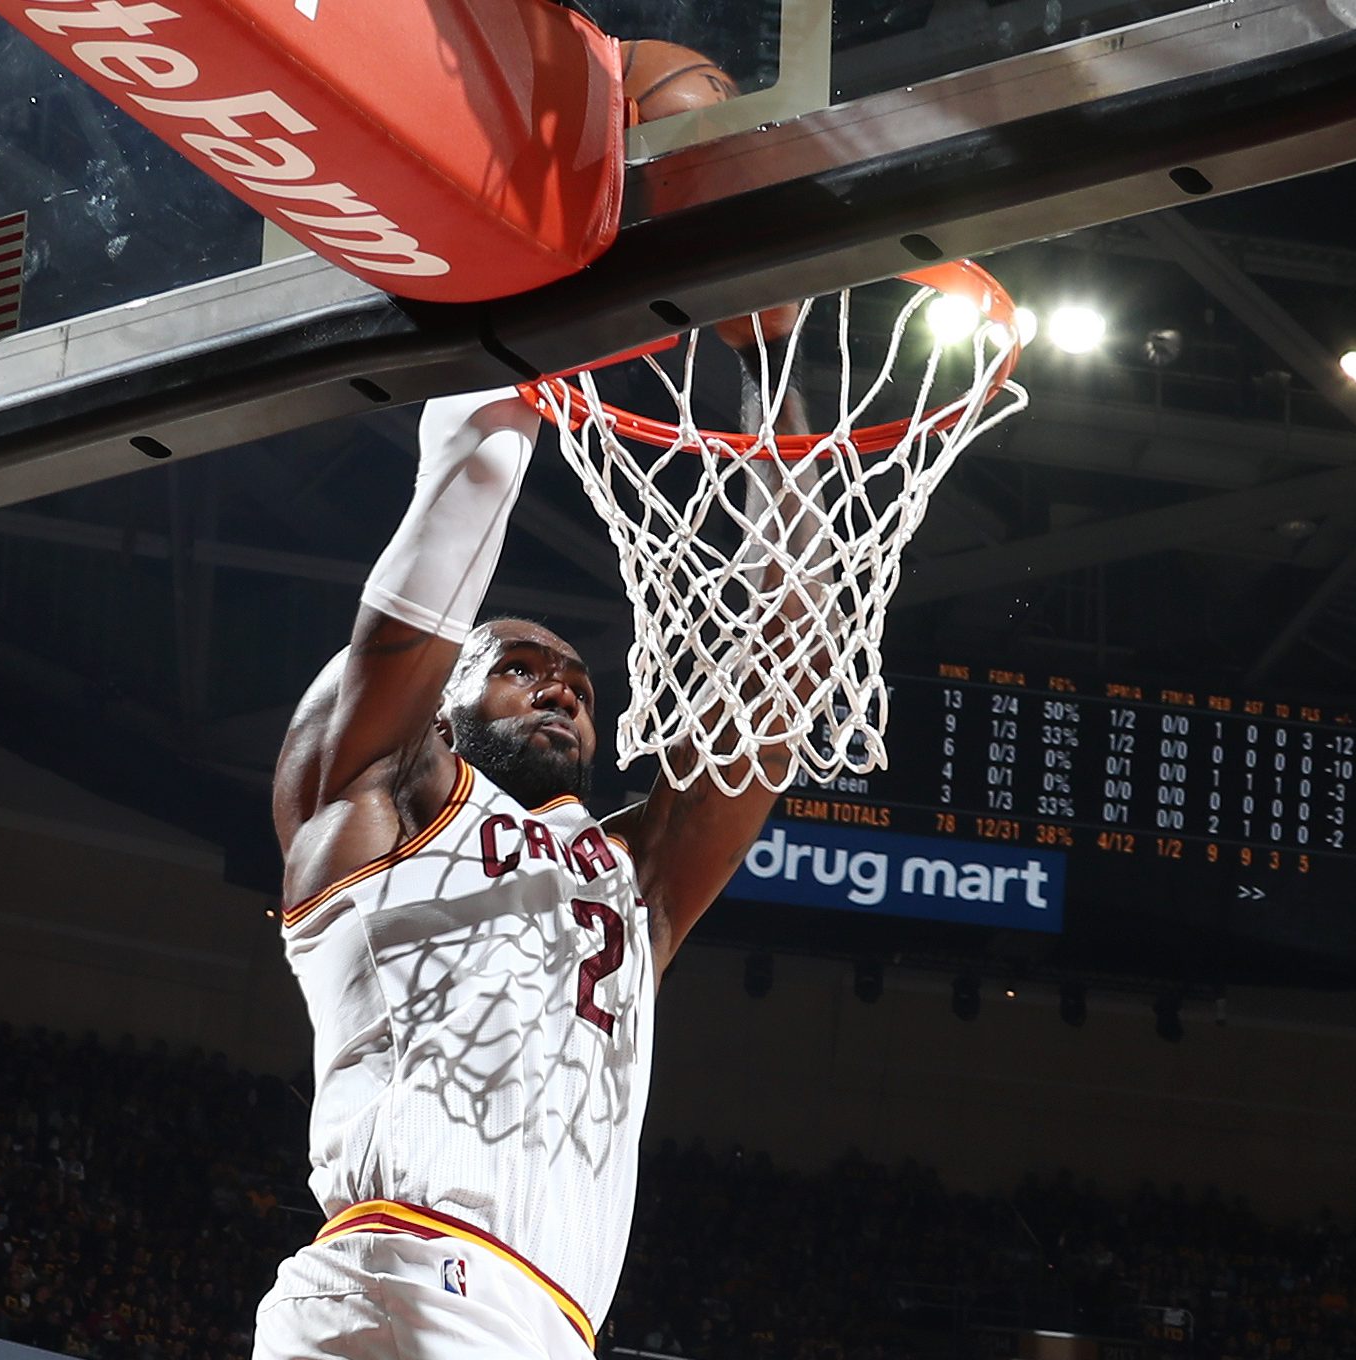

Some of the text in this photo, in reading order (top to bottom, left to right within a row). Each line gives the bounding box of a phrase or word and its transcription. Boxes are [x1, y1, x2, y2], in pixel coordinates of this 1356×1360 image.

[125, 90, 451, 277] Farm
[944, 689, 963, 709] 13
[991, 694, 1019, 715] 2/4
[1043, 701, 1080, 723] 50%
[1109, 709, 1136, 730] 1/2
[1161, 714, 1189, 735] 0/0
[1214, 721, 1223, 740] 1
[1247, 725, 1258, 744] 0
[1275, 728, 1287, 747] 0
[1302, 732, 1313, 751] 3
[1325, 736, 1355, 756] -12
[945, 713, 956, 733] 9
[990, 719, 1017, 740] 1/3
[1041, 725, 1079, 747] 33%
[1108, 733, 1135, 754] 1/2
[1160, 738, 1188, 760] 0/0
[1325, 760, 1353, 780] -10
[941, 761, 953, 781] 4
[987, 765, 1013, 787] 0/1
[1043, 772, 1071, 794] 0%
[1104, 779, 1132, 800] 0/0
[1157, 785, 1185, 807] 0/0
[1326, 806, 1344, 826] -3
[944, 737, 955, 757] 6
[988, 742, 1016, 764] 0/3
[1044, 749, 1072, 770] 0%
[1106, 756, 1131, 777] 0/1
[1158, 762, 1187, 783] 0/0
[1328, 783, 1346, 802] -3
[785, 798, 829, 820] TEAM
[833, 804, 892, 827] TOTALS
[935, 812, 956, 832] 78
[976, 817, 1020, 839] 12/31
[1036, 823, 1074, 846] 38%
[1096, 831, 1135, 853] 4/12
[1156, 838, 1184, 859] 1/2
[1206, 843, 1219, 863] 9
[1240, 847, 1253, 867] 9
[1269, 850, 1282, 870] 3
[1298, 854, 1310, 873] 5
[940, 785, 952, 804] 3
[987, 790, 1013, 811] 1/3
[1038, 795, 1075, 818] 33%
[1102, 802, 1129, 824] 0/1
[1156, 809, 1184, 830] 0/0
[1325, 829, 1344, 849] -2
[745, 828, 1049, 910] drug mart
[571, 898, 624, 1037] 2
